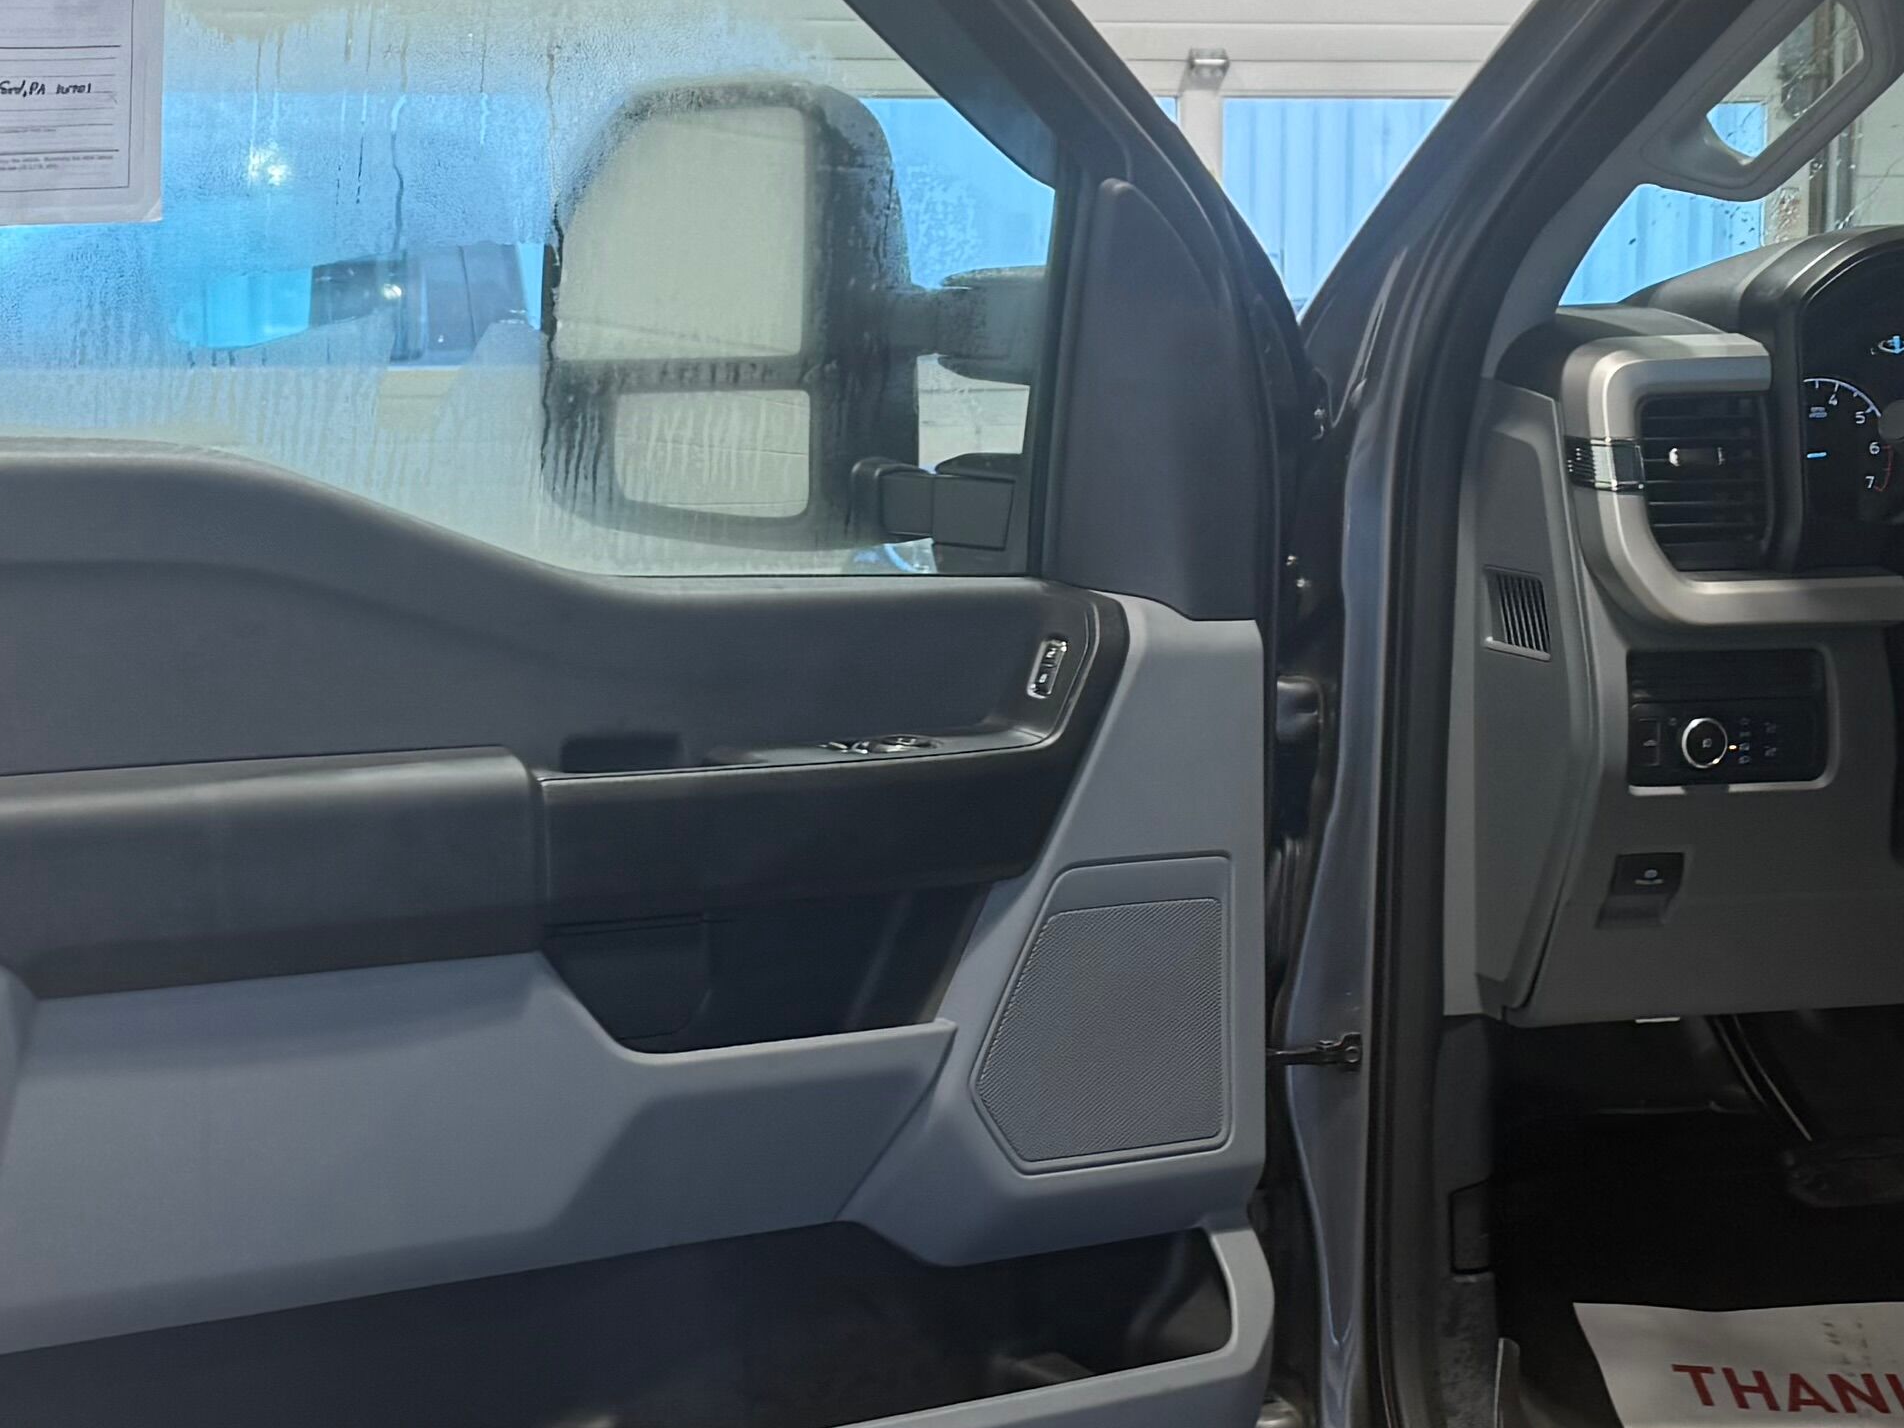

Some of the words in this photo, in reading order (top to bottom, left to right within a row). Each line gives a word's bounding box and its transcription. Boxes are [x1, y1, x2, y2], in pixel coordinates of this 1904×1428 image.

[1828, 394, 1838, 406] 4
[1855, 411, 1866, 424] 5
[1869, 442, 1880, 455] 6
[1865, 475, 1875, 489] 7
